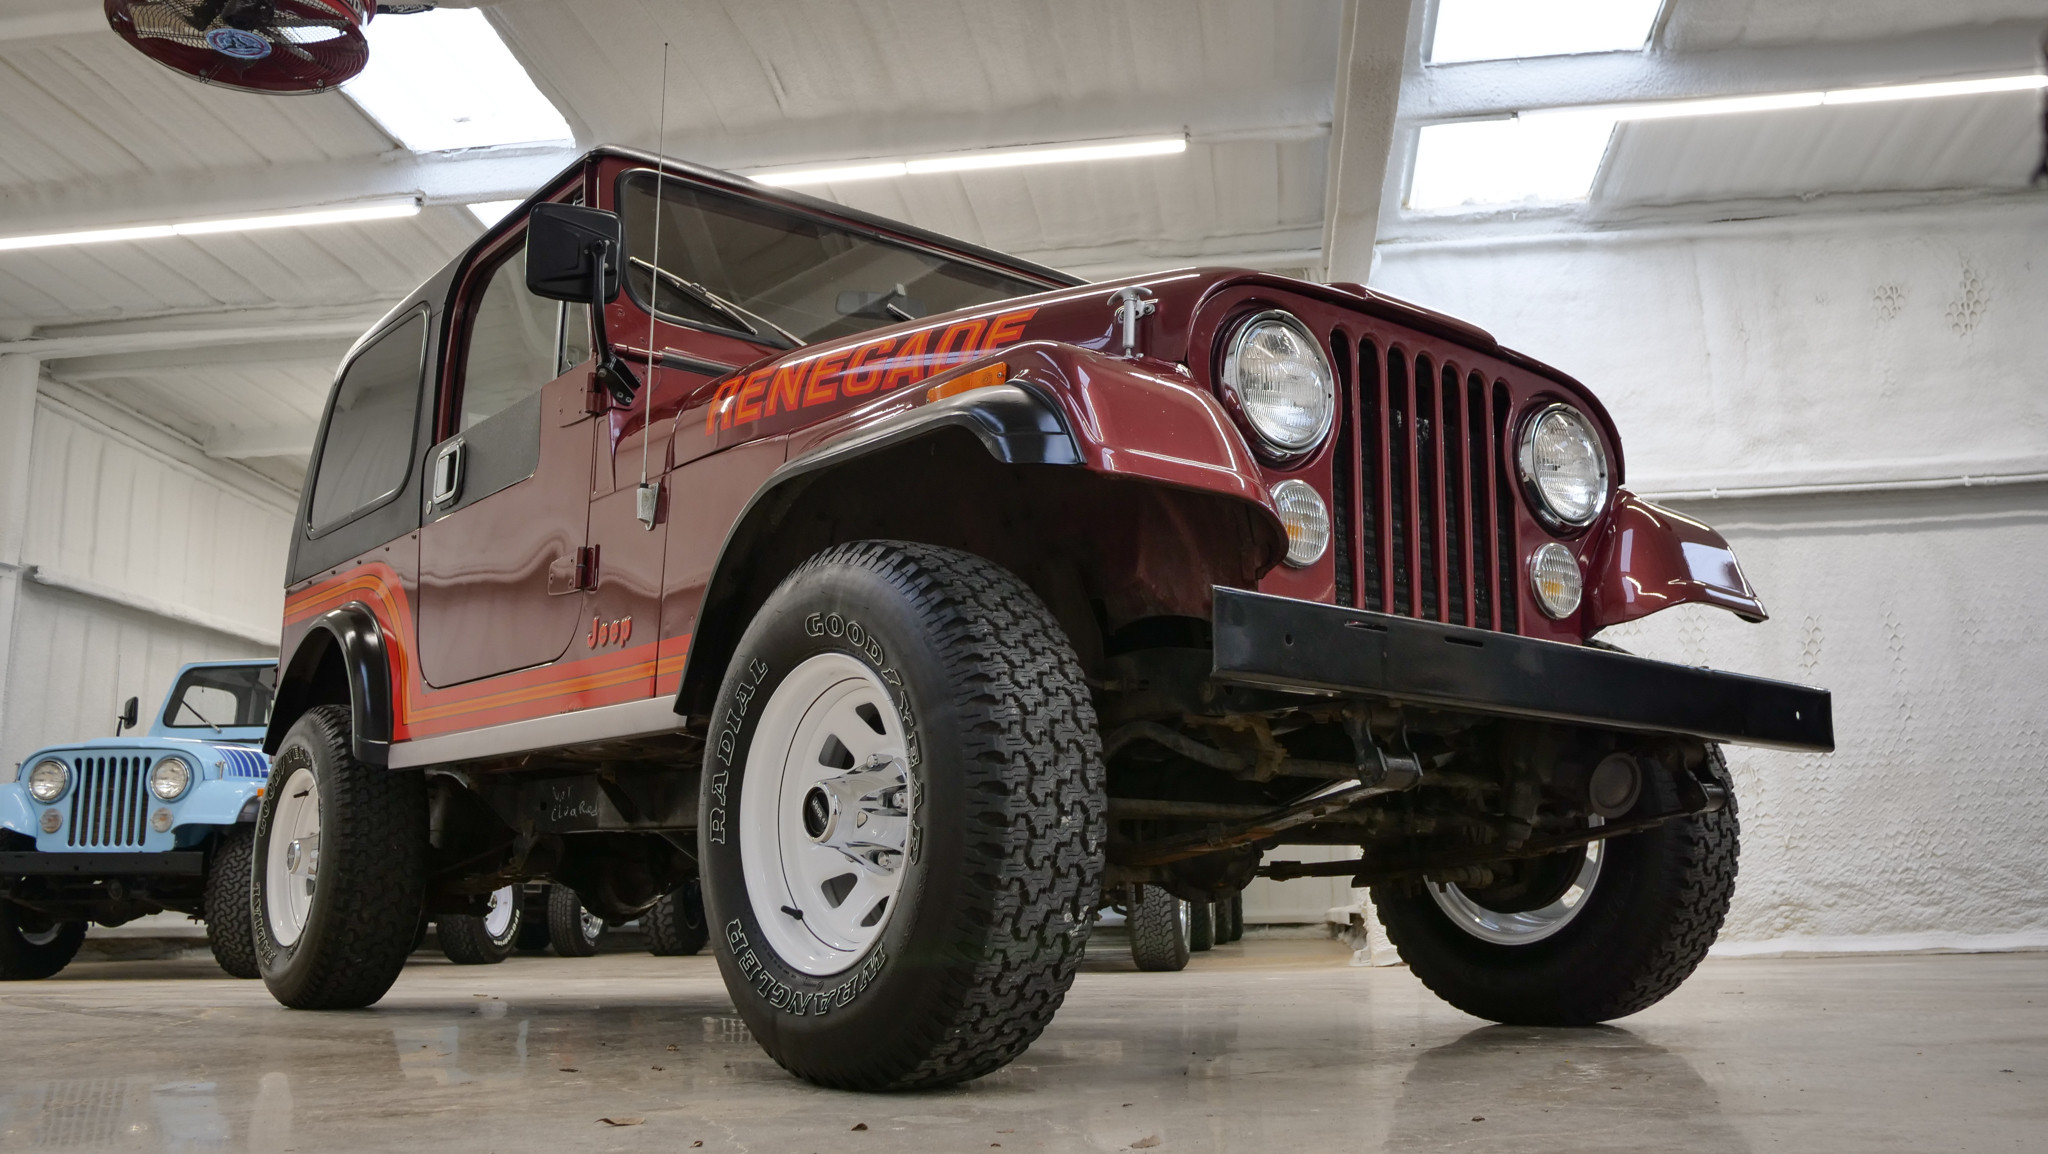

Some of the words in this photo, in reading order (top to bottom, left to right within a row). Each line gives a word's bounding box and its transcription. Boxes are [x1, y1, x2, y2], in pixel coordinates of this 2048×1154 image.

[705, 308, 1038, 436] RENEGADE
[587, 616, 632, 650] Jeep
[708, 657, 769, 845] RADIAL
[804, 611, 922, 866] GOODYEAR
[715, 918, 889, 1016] WRANGLER
